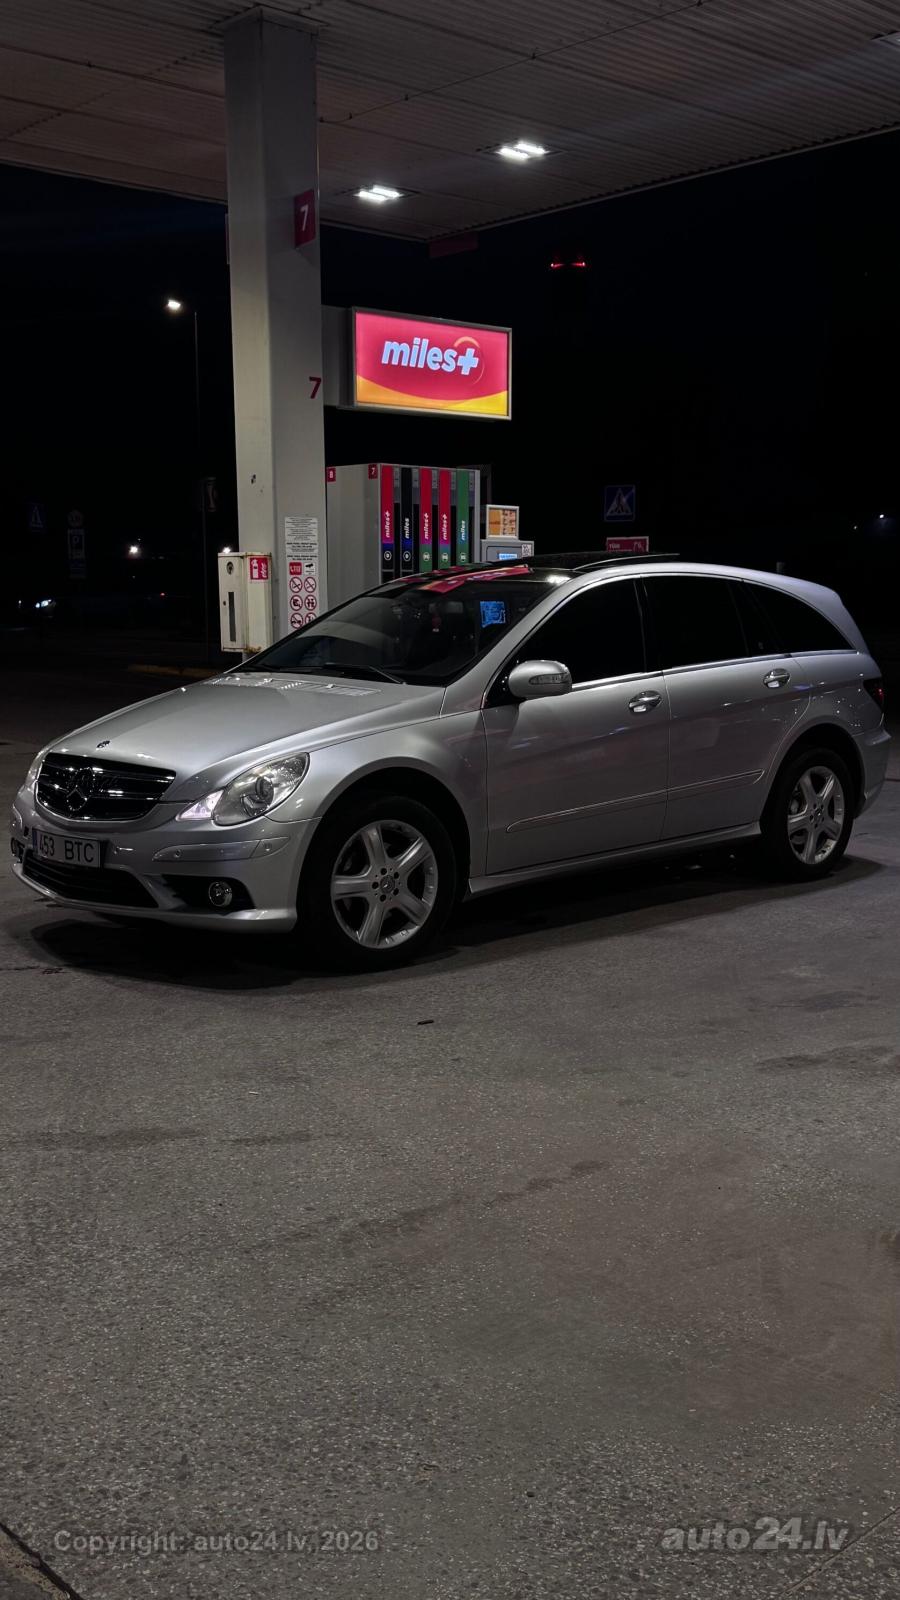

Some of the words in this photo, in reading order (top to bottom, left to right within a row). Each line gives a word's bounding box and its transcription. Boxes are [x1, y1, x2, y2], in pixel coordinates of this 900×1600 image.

[300, 204, 309, 231] 7
[381, 337, 479, 376] miles+
[309, 376, 322, 399] 7
[65, 841, 94, 862] BTC
